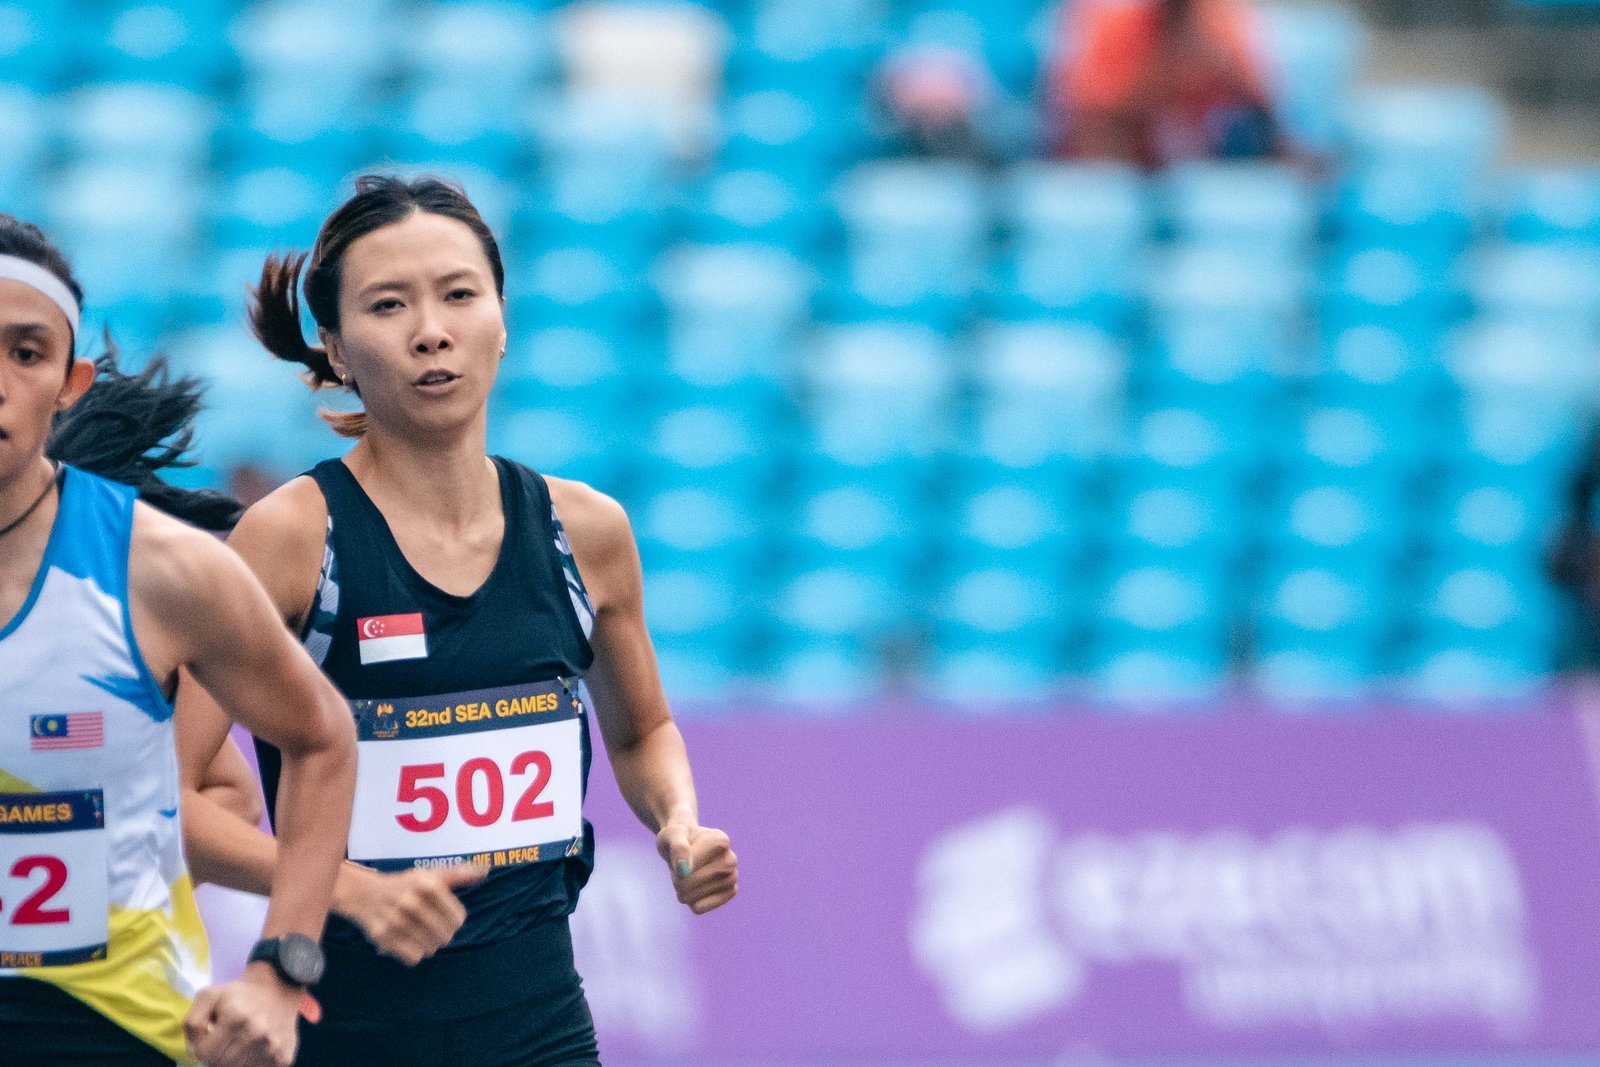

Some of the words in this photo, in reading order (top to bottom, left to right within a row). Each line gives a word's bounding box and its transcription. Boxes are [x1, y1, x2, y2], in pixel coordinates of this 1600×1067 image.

[405, 707, 451, 728] 32nd
[455, 702, 492, 723] SEA
[495, 693, 558, 718] GAMES
[394, 750, 554, 833] 502
[494, 851, 507, 866] IN
[508, 846, 540, 865] PEACE
